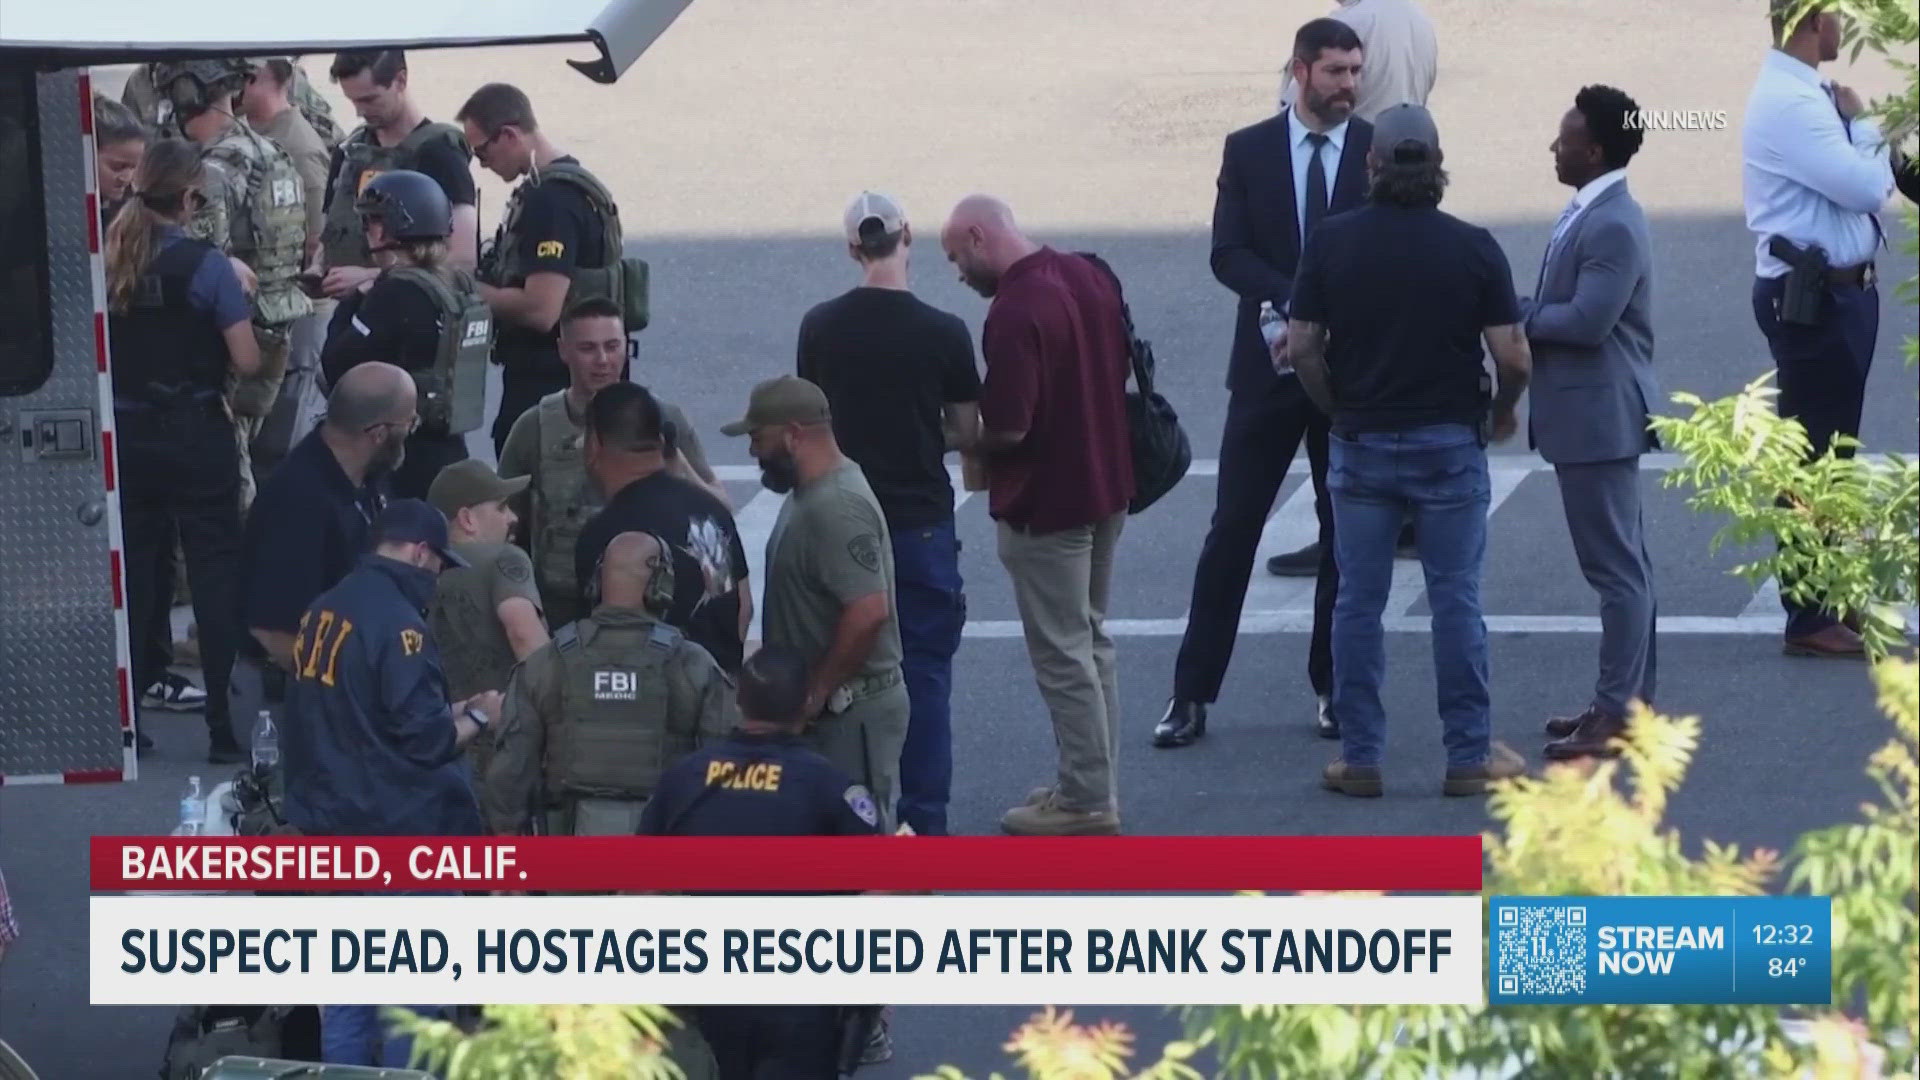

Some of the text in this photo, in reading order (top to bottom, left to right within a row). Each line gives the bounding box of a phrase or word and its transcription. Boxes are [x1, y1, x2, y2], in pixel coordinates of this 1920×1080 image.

[272, 177, 305, 207] FBI
[467, 319, 489, 338] FBI
[594, 671, 637, 692] FBI
[594, 692, 636, 701] MEDIC
[705, 760, 782, 791] POLICE
